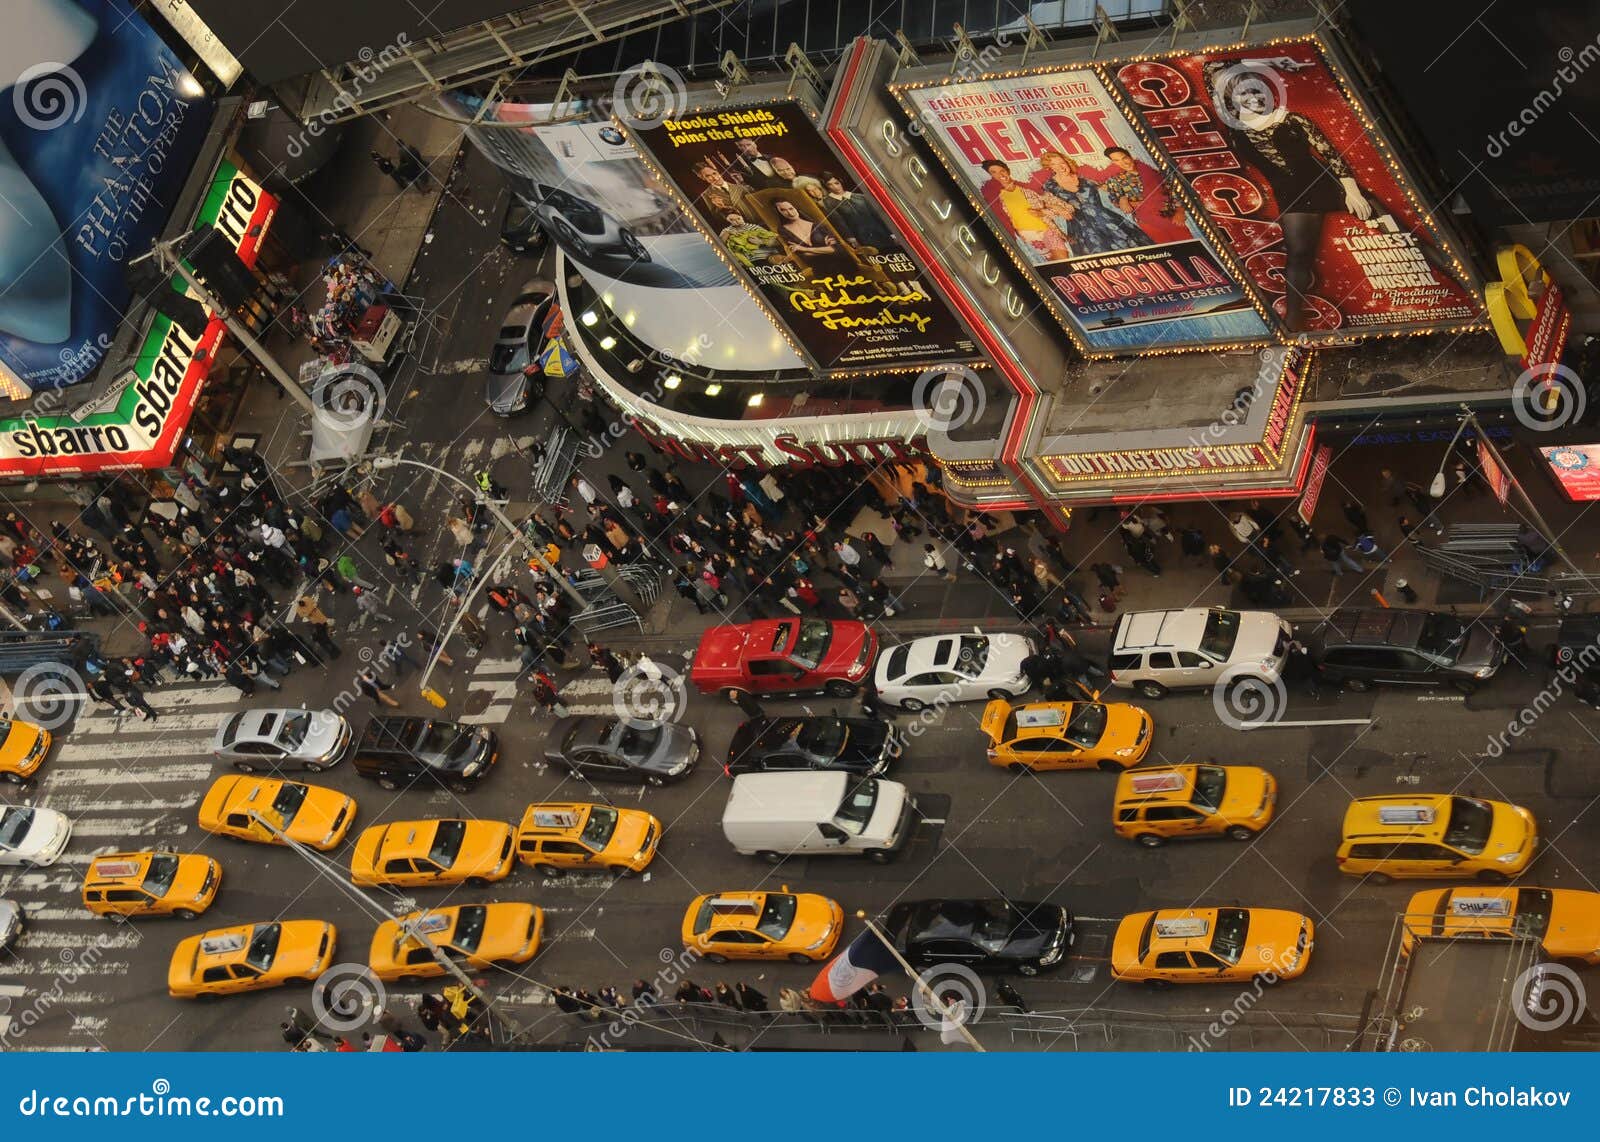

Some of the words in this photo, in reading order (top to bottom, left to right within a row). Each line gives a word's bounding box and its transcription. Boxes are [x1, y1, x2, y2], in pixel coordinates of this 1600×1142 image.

[928, 95, 986, 110] BENEATH
[987, 91, 1014, 104] ALL
[1015, 86, 1048, 101] THAT
[1052, 83, 1090, 98] GLITZ
[663, 113, 720, 132] Brooke
[721, 108, 775, 128] Shields
[938, 110, 974, 123] BEATS
[975, 109, 983, 119] A
[985, 106, 1018, 118] GREAT
[94, 107, 126, 160] THE
[668, 129, 708, 148] joins
[709, 126, 733, 142] the
[734, 121, 788, 140] family!
[76, 54, 182, 262] PHANTOM
[108, 225, 129, 262] OF
[123, 171, 154, 224] THE
[147, 99, 190, 175] OPERA
[1117, 62, 1343, 332] CHICAGO
[882, 119, 1025, 318] PALACE
[1344, 227, 1366, 236] The
[868, 252, 910, 265] ROGER
[889, 261, 916, 273] REES
[1135, 250, 1172, 262] Presents
[1351, 247, 1425, 265] RUNNING
[750, 263, 797, 276] BROOKE
[759, 272, 806, 286] SHIELDS
[1362, 261, 1431, 276] AMERICAN
[811, 274, 872, 291] The
[1051, 255, 1230, 306] PRISCILLA
[1367, 272, 1440, 290] MUSICAL
[789, 289, 924, 312] Addams
[1078, 301, 1124, 315] QUEEN
[1130, 298, 1145, 307] OF
[1150, 294, 1174, 304] THE
[1178, 285, 1232, 300] DESERT
[1371, 291, 1384, 299] in
[1385, 287, 1452, 299] Broadway
[1391, 295, 1441, 307] History!
[812, 308, 932, 333] Family
[1527, 284, 1559, 370] McDonald's
[136, 322, 200, 438] sbarr
[13, 421, 130, 458] sbarro
[1061, 450, 1199, 475] OUTRAGEOUS
[1203, 446, 1260, 467] FUN!
[1459, 903, 1489, 911] CHILE
